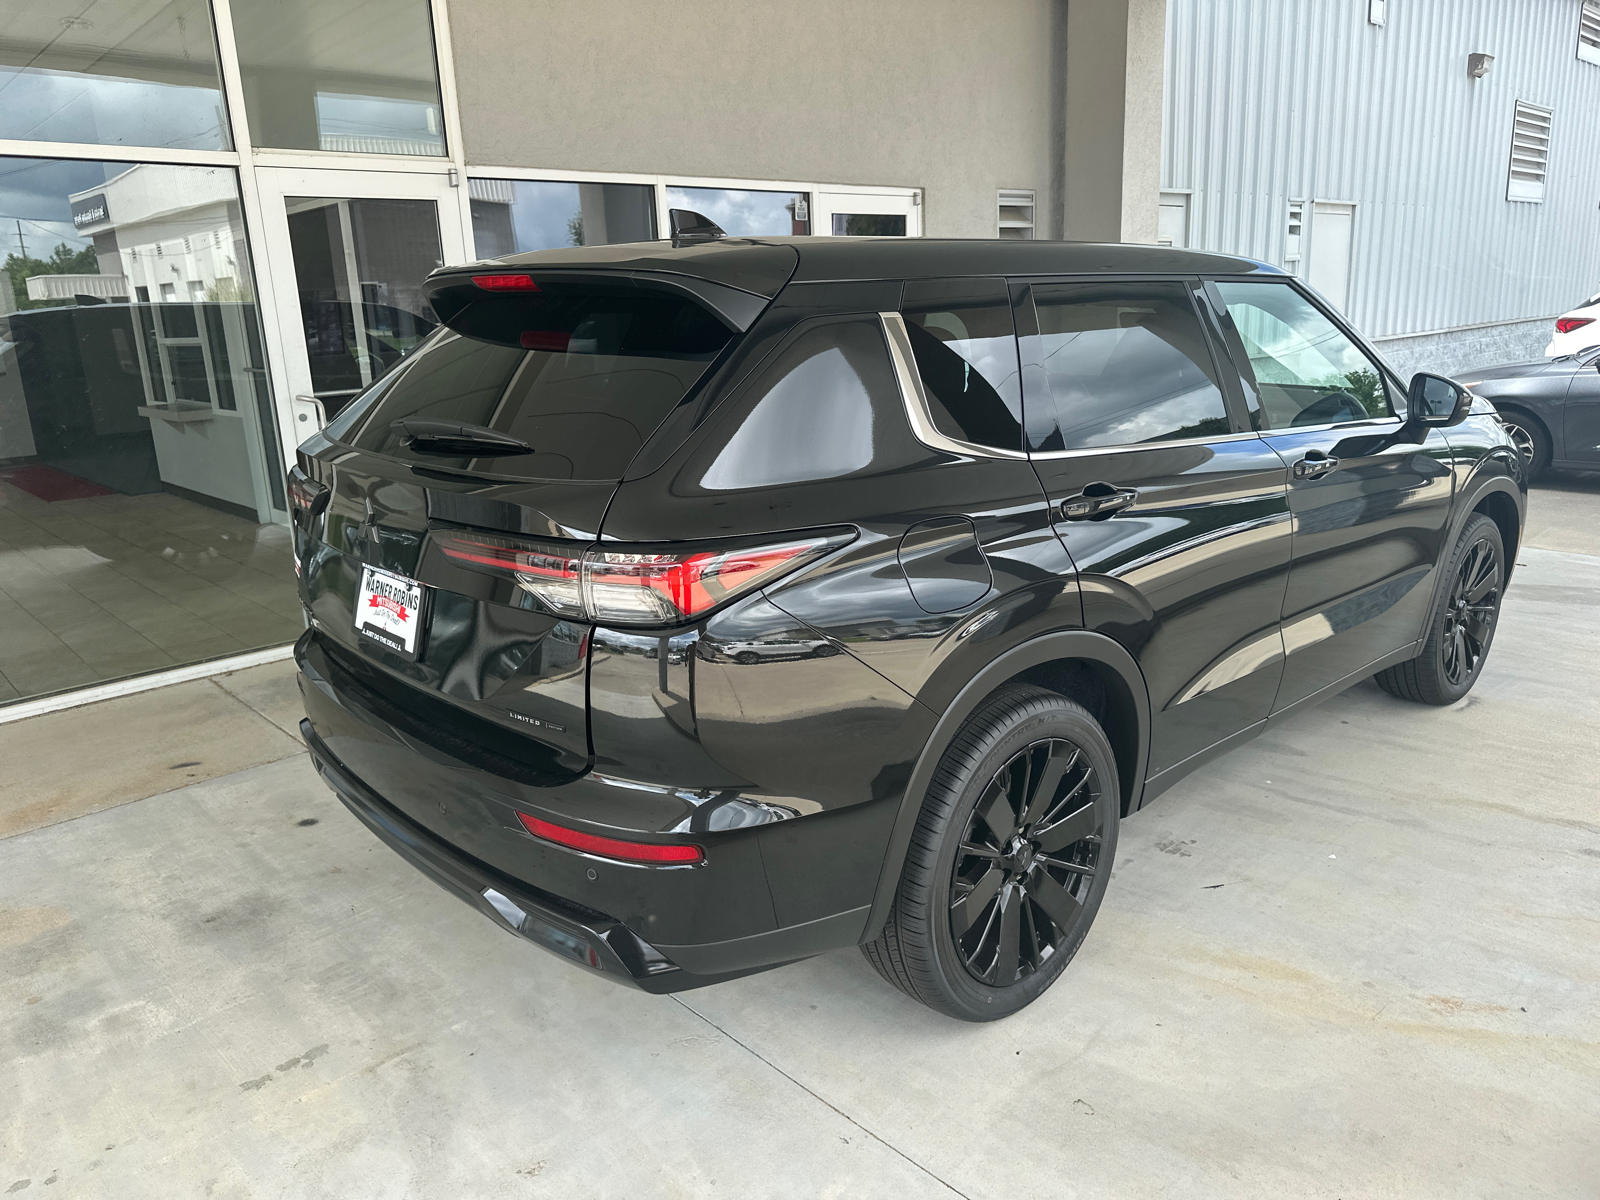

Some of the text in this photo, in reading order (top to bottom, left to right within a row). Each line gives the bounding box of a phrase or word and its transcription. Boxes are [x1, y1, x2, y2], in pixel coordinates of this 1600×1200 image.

[366, 576, 418, 611] WARNER ROBINS
[509, 712, 540, 726] LIMITED
[982, 723, 1032, 772] COUNTRY
